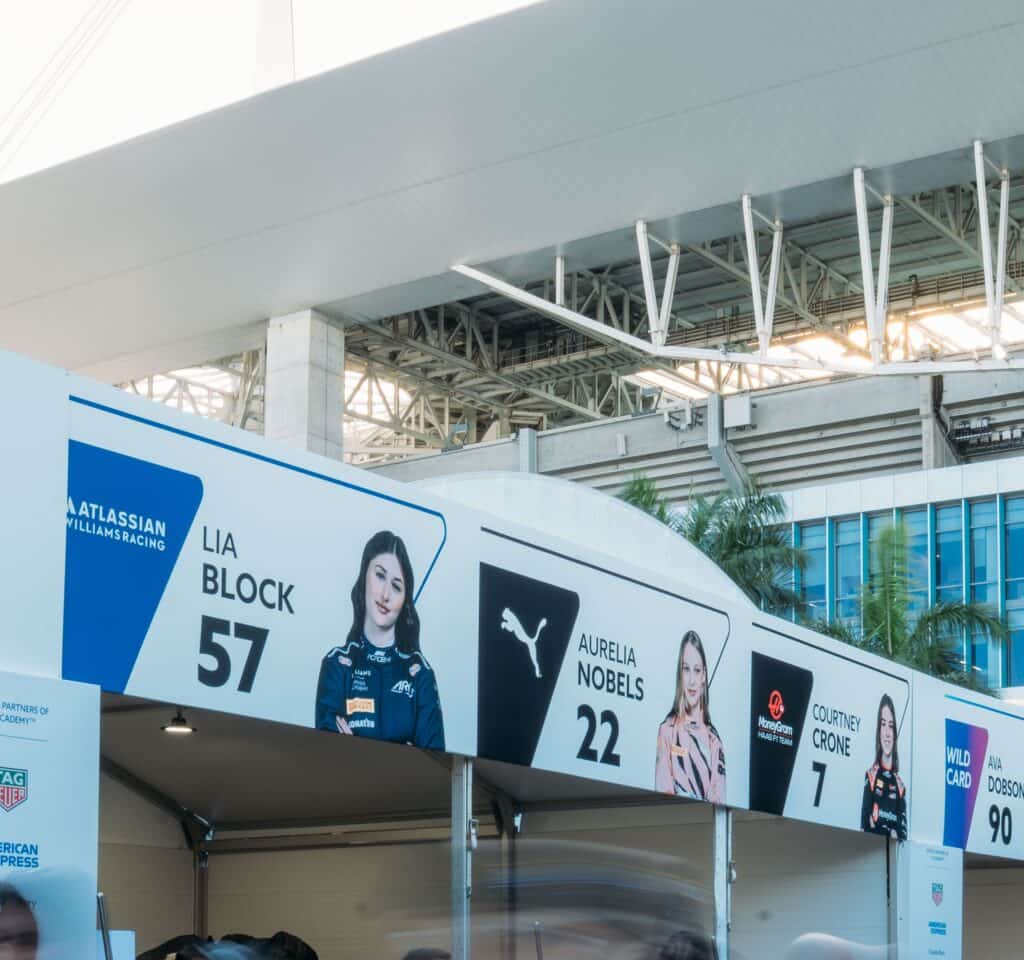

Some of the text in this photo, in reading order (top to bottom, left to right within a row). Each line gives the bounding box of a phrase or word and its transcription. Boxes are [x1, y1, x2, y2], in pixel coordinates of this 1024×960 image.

[78, 500, 166, 537] ATLASSIAN
[202, 525, 238, 559] LIA
[202, 562, 295, 615] BLOCK
[197, 614, 270, 693] 57
[578, 632, 637, 668] AURELIA
[577, 660, 644, 702] NOBELS
[2, 701, 39, 714] PARTNERS
[812, 703, 861, 733] COURTNEY
[575, 703, 621, 768] 22
[758, 715, 793, 736] MoneyGram
[812, 727, 851, 758] CRONE
[946, 745, 971, 767] WILD
[988, 755, 1002, 770] AVA
[812, 760, 828, 808] 7
[946, 767, 972, 789] CARD
[988, 775, 1024, 800] DOBSON
[989, 803, 1013, 846] 90
